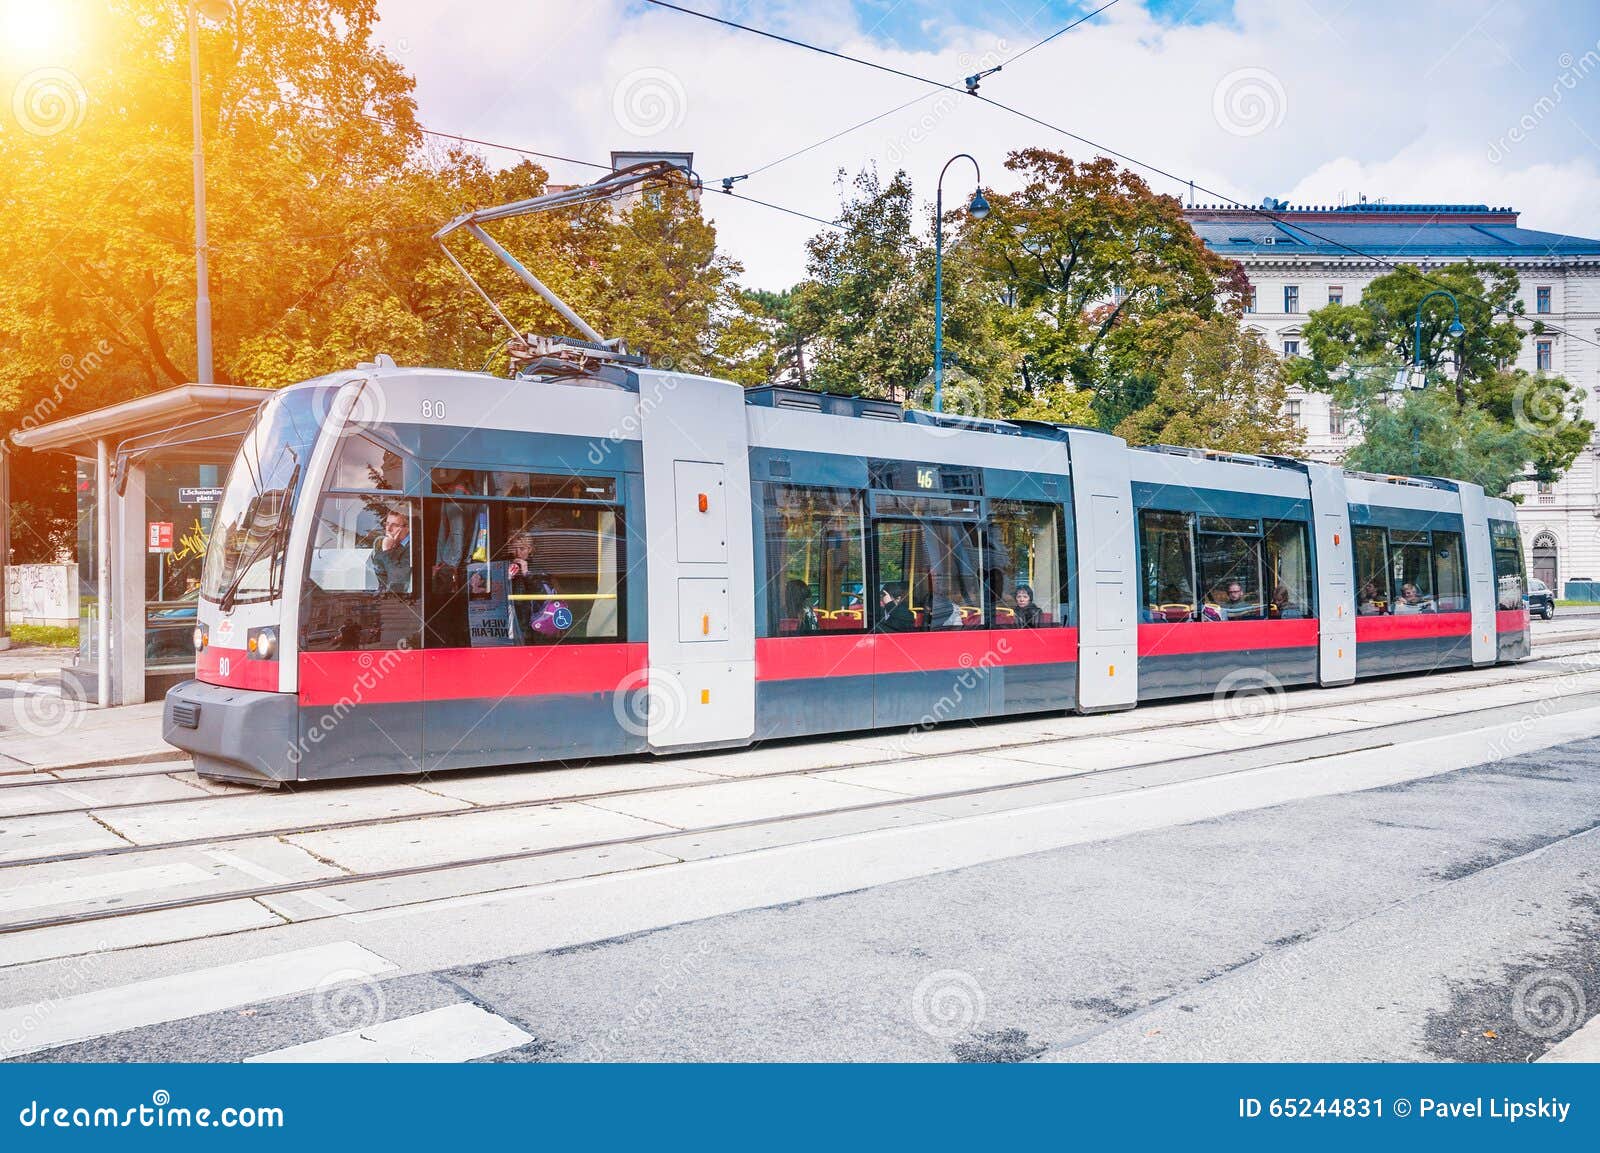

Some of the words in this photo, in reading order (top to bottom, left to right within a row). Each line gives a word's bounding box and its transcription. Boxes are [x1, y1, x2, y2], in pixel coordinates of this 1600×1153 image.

[422, 399, 446, 419] 80
[917, 470, 933, 489] 46
[219, 657, 230, 676] 80
